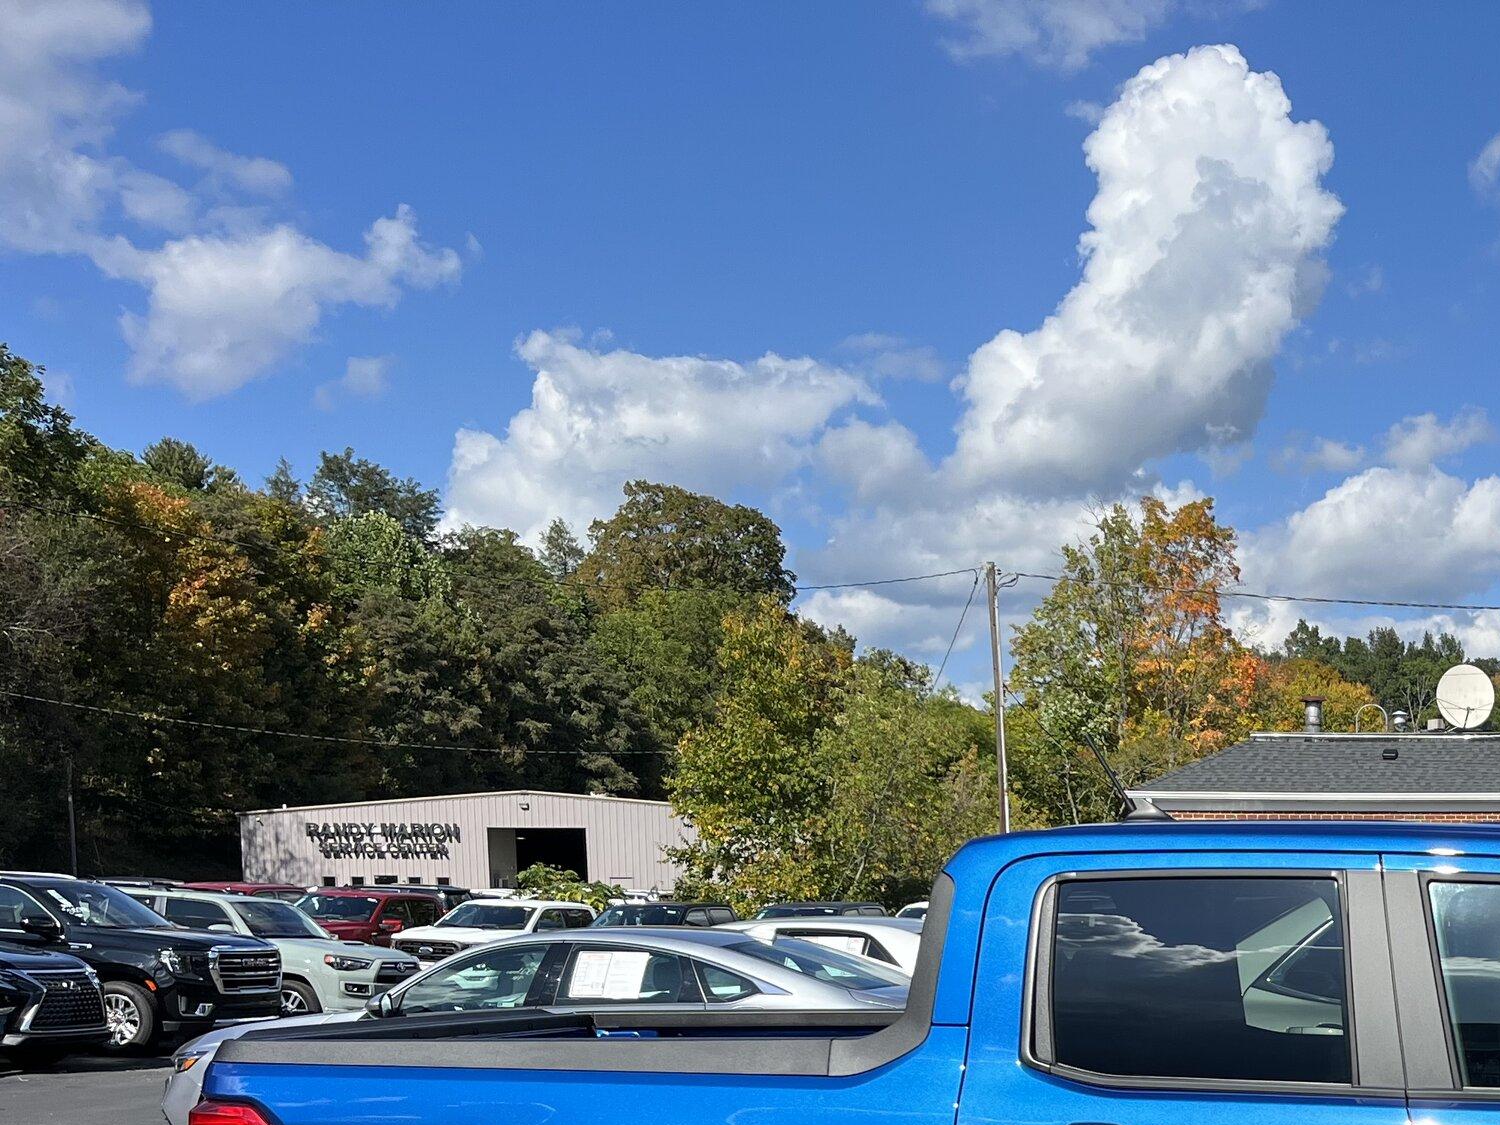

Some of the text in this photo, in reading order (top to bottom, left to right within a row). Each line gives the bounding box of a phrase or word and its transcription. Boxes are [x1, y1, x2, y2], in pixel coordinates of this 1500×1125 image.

[305, 822, 460, 839] RANDY MARION
[319, 842, 450, 857] SERVICE CENTER
